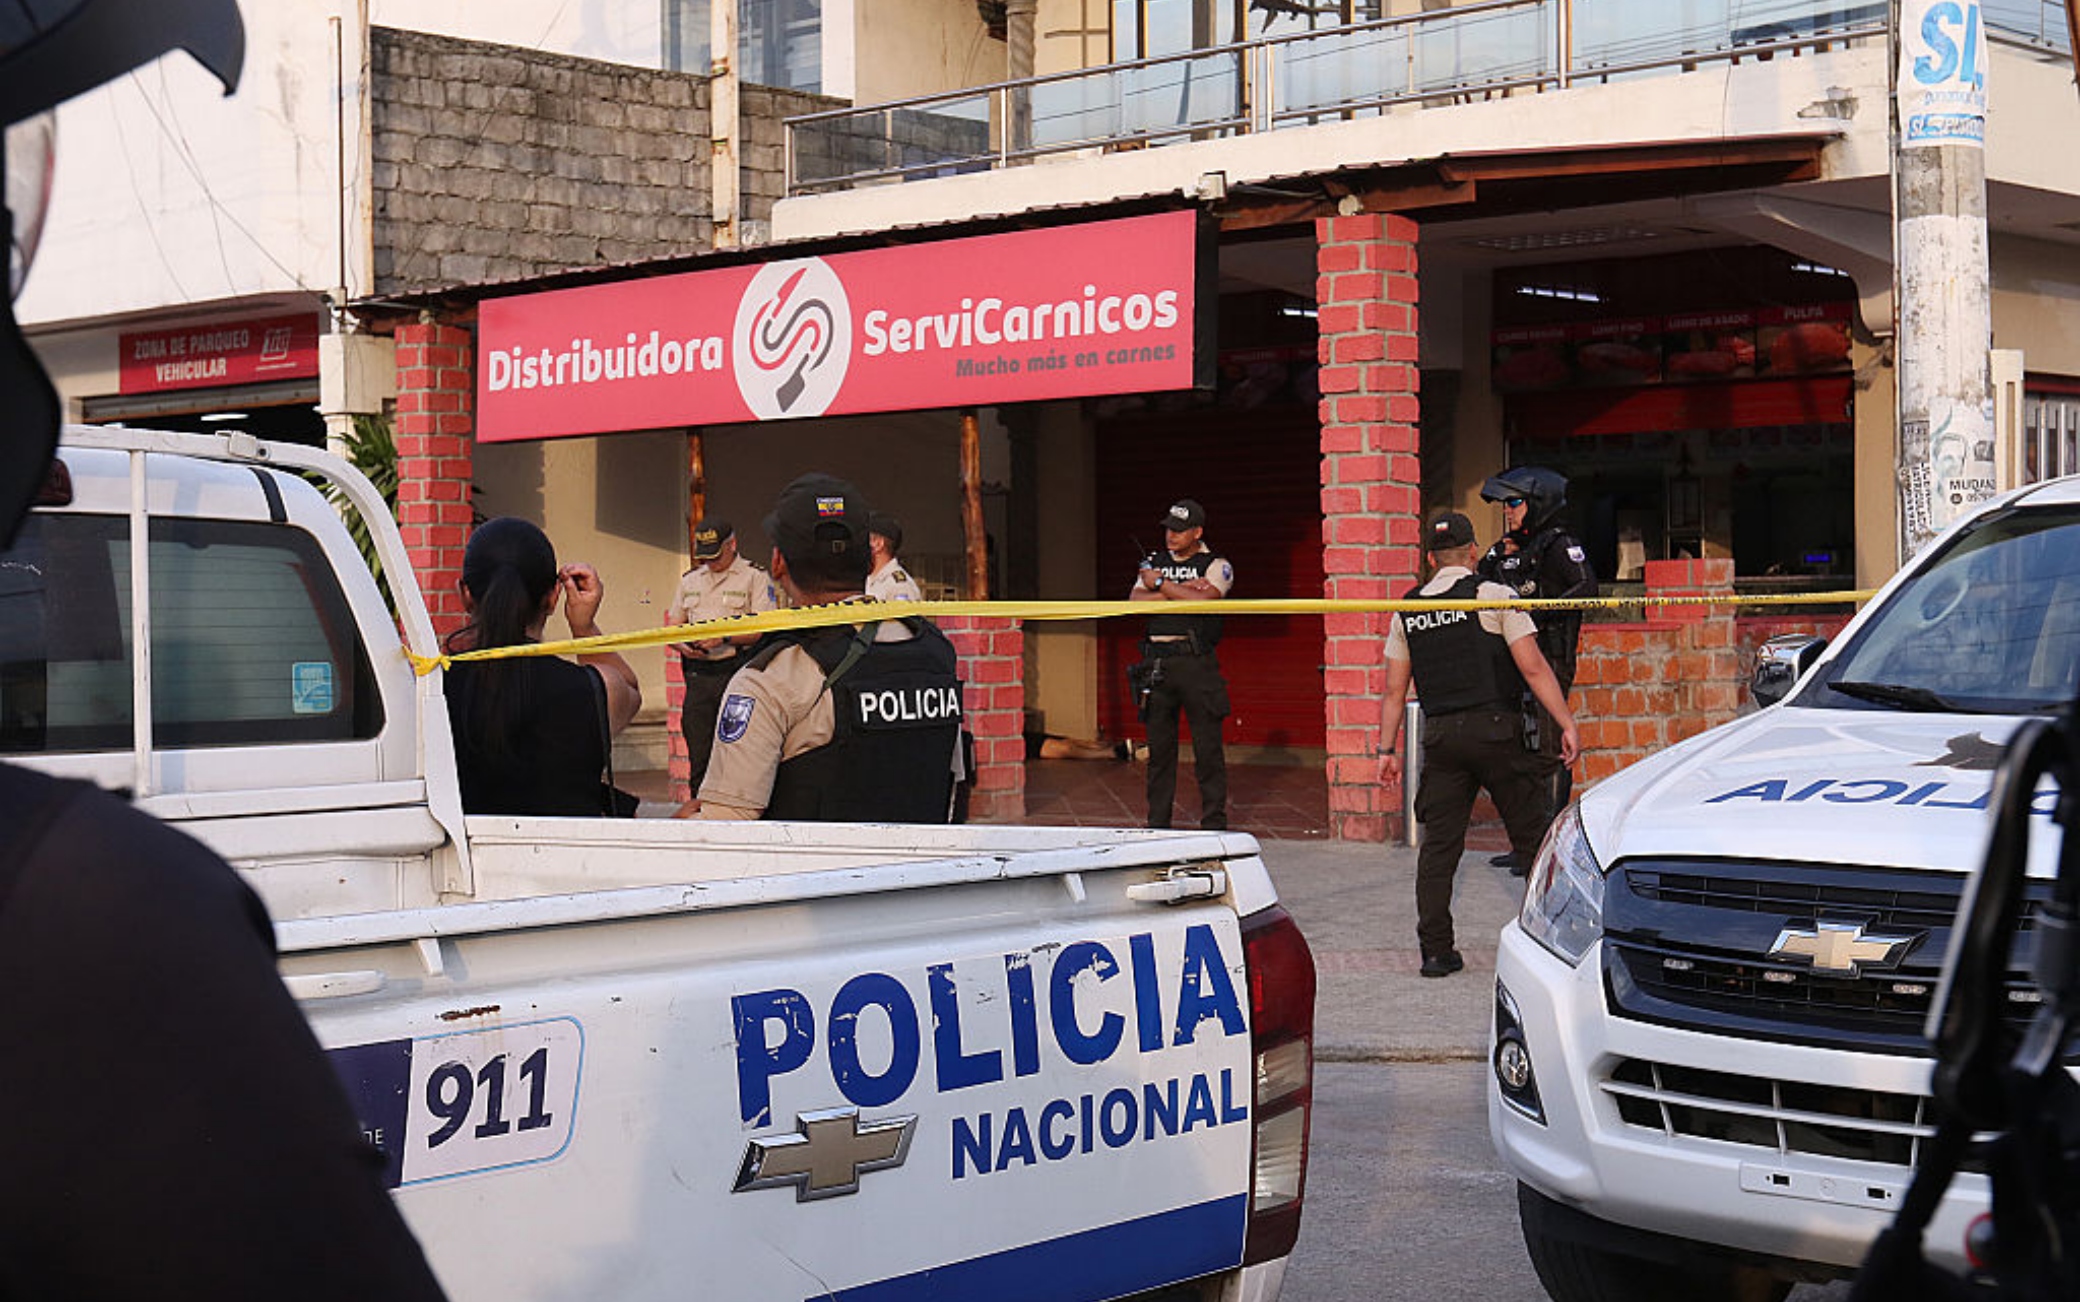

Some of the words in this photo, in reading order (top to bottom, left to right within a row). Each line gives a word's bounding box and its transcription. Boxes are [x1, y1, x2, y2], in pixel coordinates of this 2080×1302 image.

[863, 284, 1178, 355] ServiCarnicos
[135, 339, 167, 359] ZONA
[170, 336, 186, 355] DE
[190, 329, 249, 354] PARQUEO
[488, 331, 723, 391] Distribuidora
[955, 356, 1021, 378] Mucho
[1027, 350, 1068, 372] más
[1075, 351, 1099, 367] en
[1106, 344, 1176, 366] carnes
[1153, 566, 1200, 580] OLICIA
[1405, 610, 1468, 633] POLICIA
[859, 687, 962, 723] POLICIA
[731, 923, 1248, 1129] POLICIA
[425, 1047, 553, 1149] 911
[951, 1068, 1248, 1180] NACIONAL
